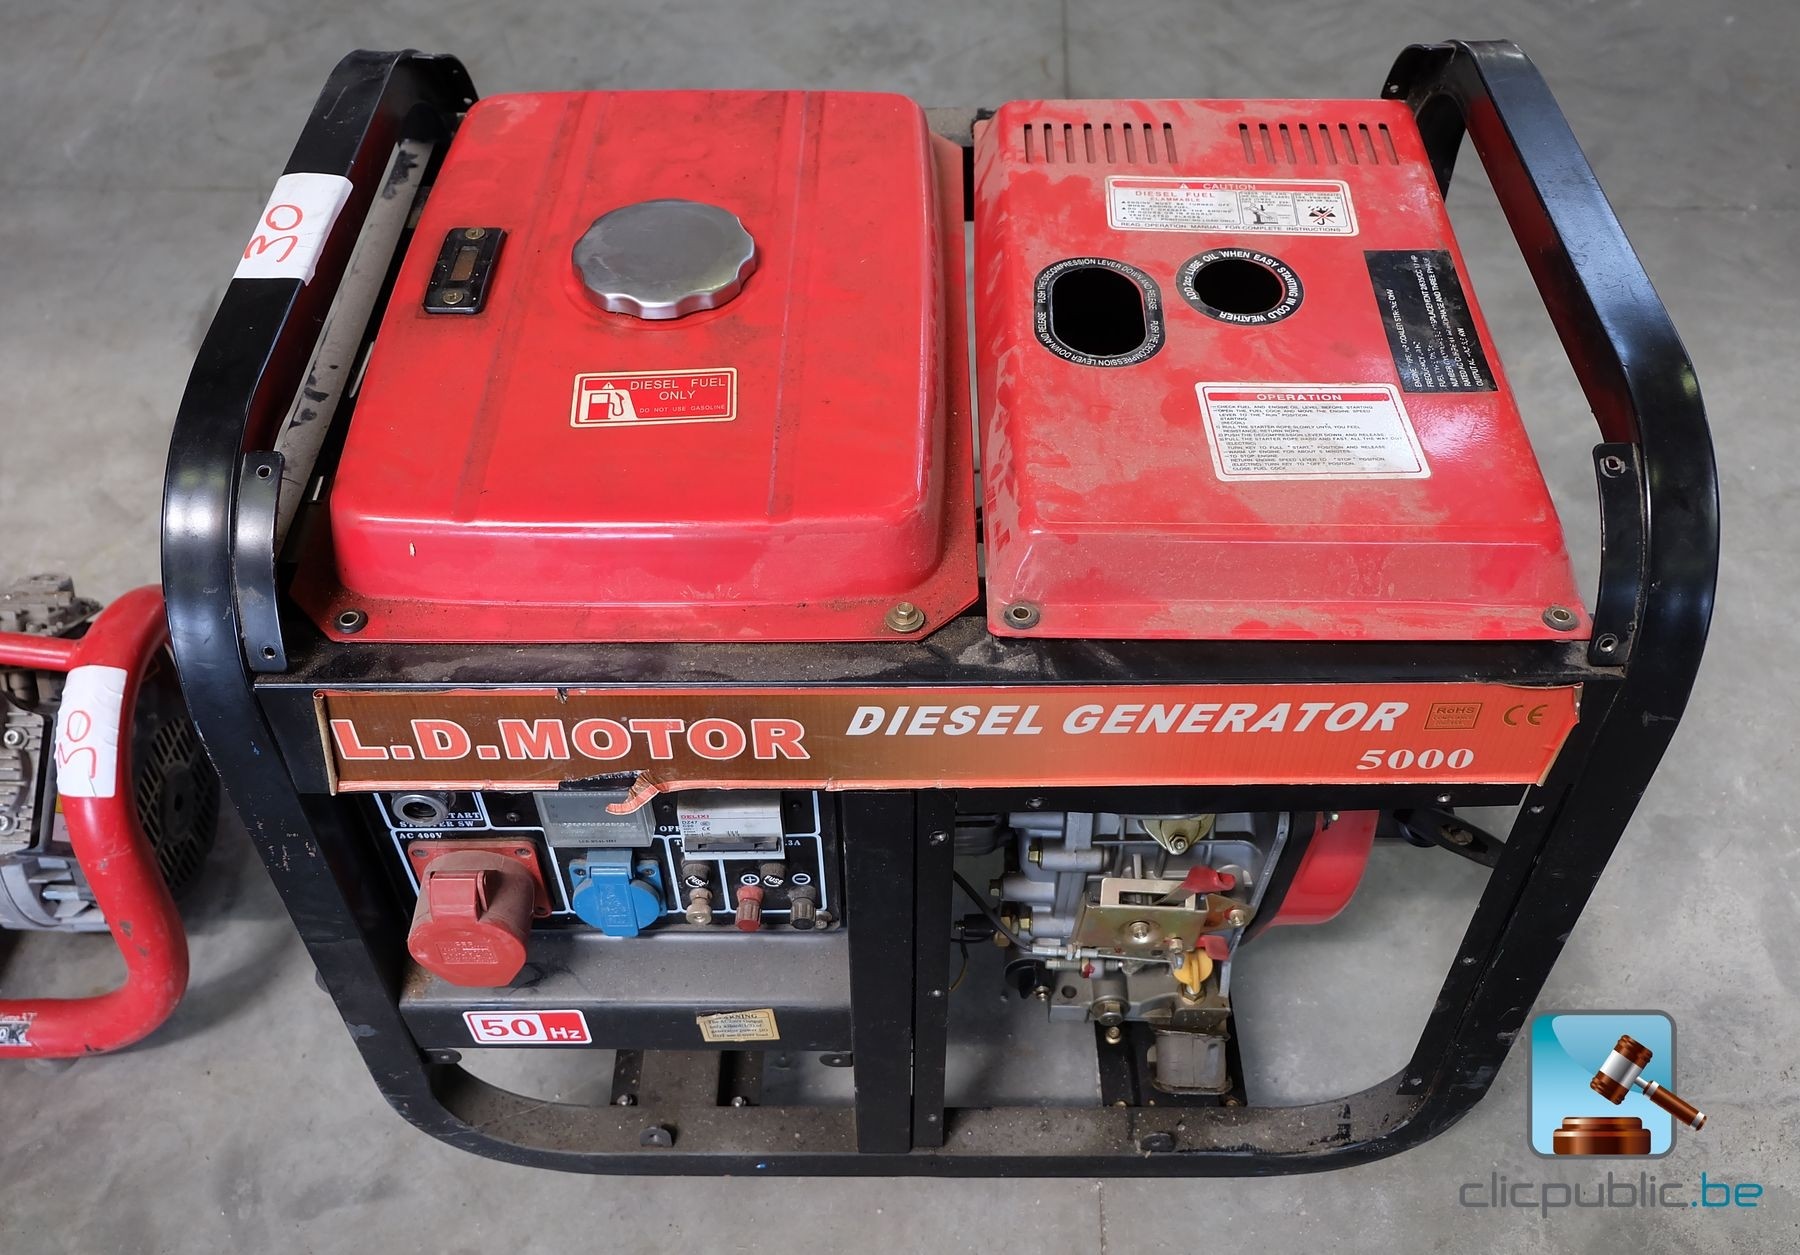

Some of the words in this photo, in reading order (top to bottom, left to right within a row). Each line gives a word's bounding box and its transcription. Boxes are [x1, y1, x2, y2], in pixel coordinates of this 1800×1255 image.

[244, 204, 303, 262] 30
[1202, 253, 1219, 262] OIL
[1219, 250, 1250, 258] WHEN
[1253, 253, 1279, 267] EASY
[1098, 260, 1121, 269] LEVER
[1189, 260, 1204, 275] LUBE
[1277, 267, 1298, 297] STARTING
[1427, 274, 1439, 290] THREE
[1184, 287, 1199, 300] ADD
[1385, 288, 1396, 300] OHV
[1286, 297, 1297, 305] IN
[1219, 311, 1267, 322] WEATHER
[1268, 305, 1291, 319] COLD
[1049, 342, 1072, 359] DOWN
[1071, 353, 1097, 365] LEVER
[1470, 365, 1484, 386] OUTPUT
[630, 381, 679, 390] DIESEL
[691, 377, 726, 387] FUEL
[659, 390, 696, 400] ONLY
[331, 718, 810, 761] L.D.MOTOR
[845, 705, 1044, 736] DIESEL
[1062, 702, 1409, 735] GENERATOR
[1503, 704, 1548, 726] CE
[1356, 748, 1475, 770] 5000
[688, 875, 708, 887] FUSE
[764, 874, 784, 885] FUSE
[481, 1018, 537, 1037] 50
[550, 1027, 582, 1040] Hz
